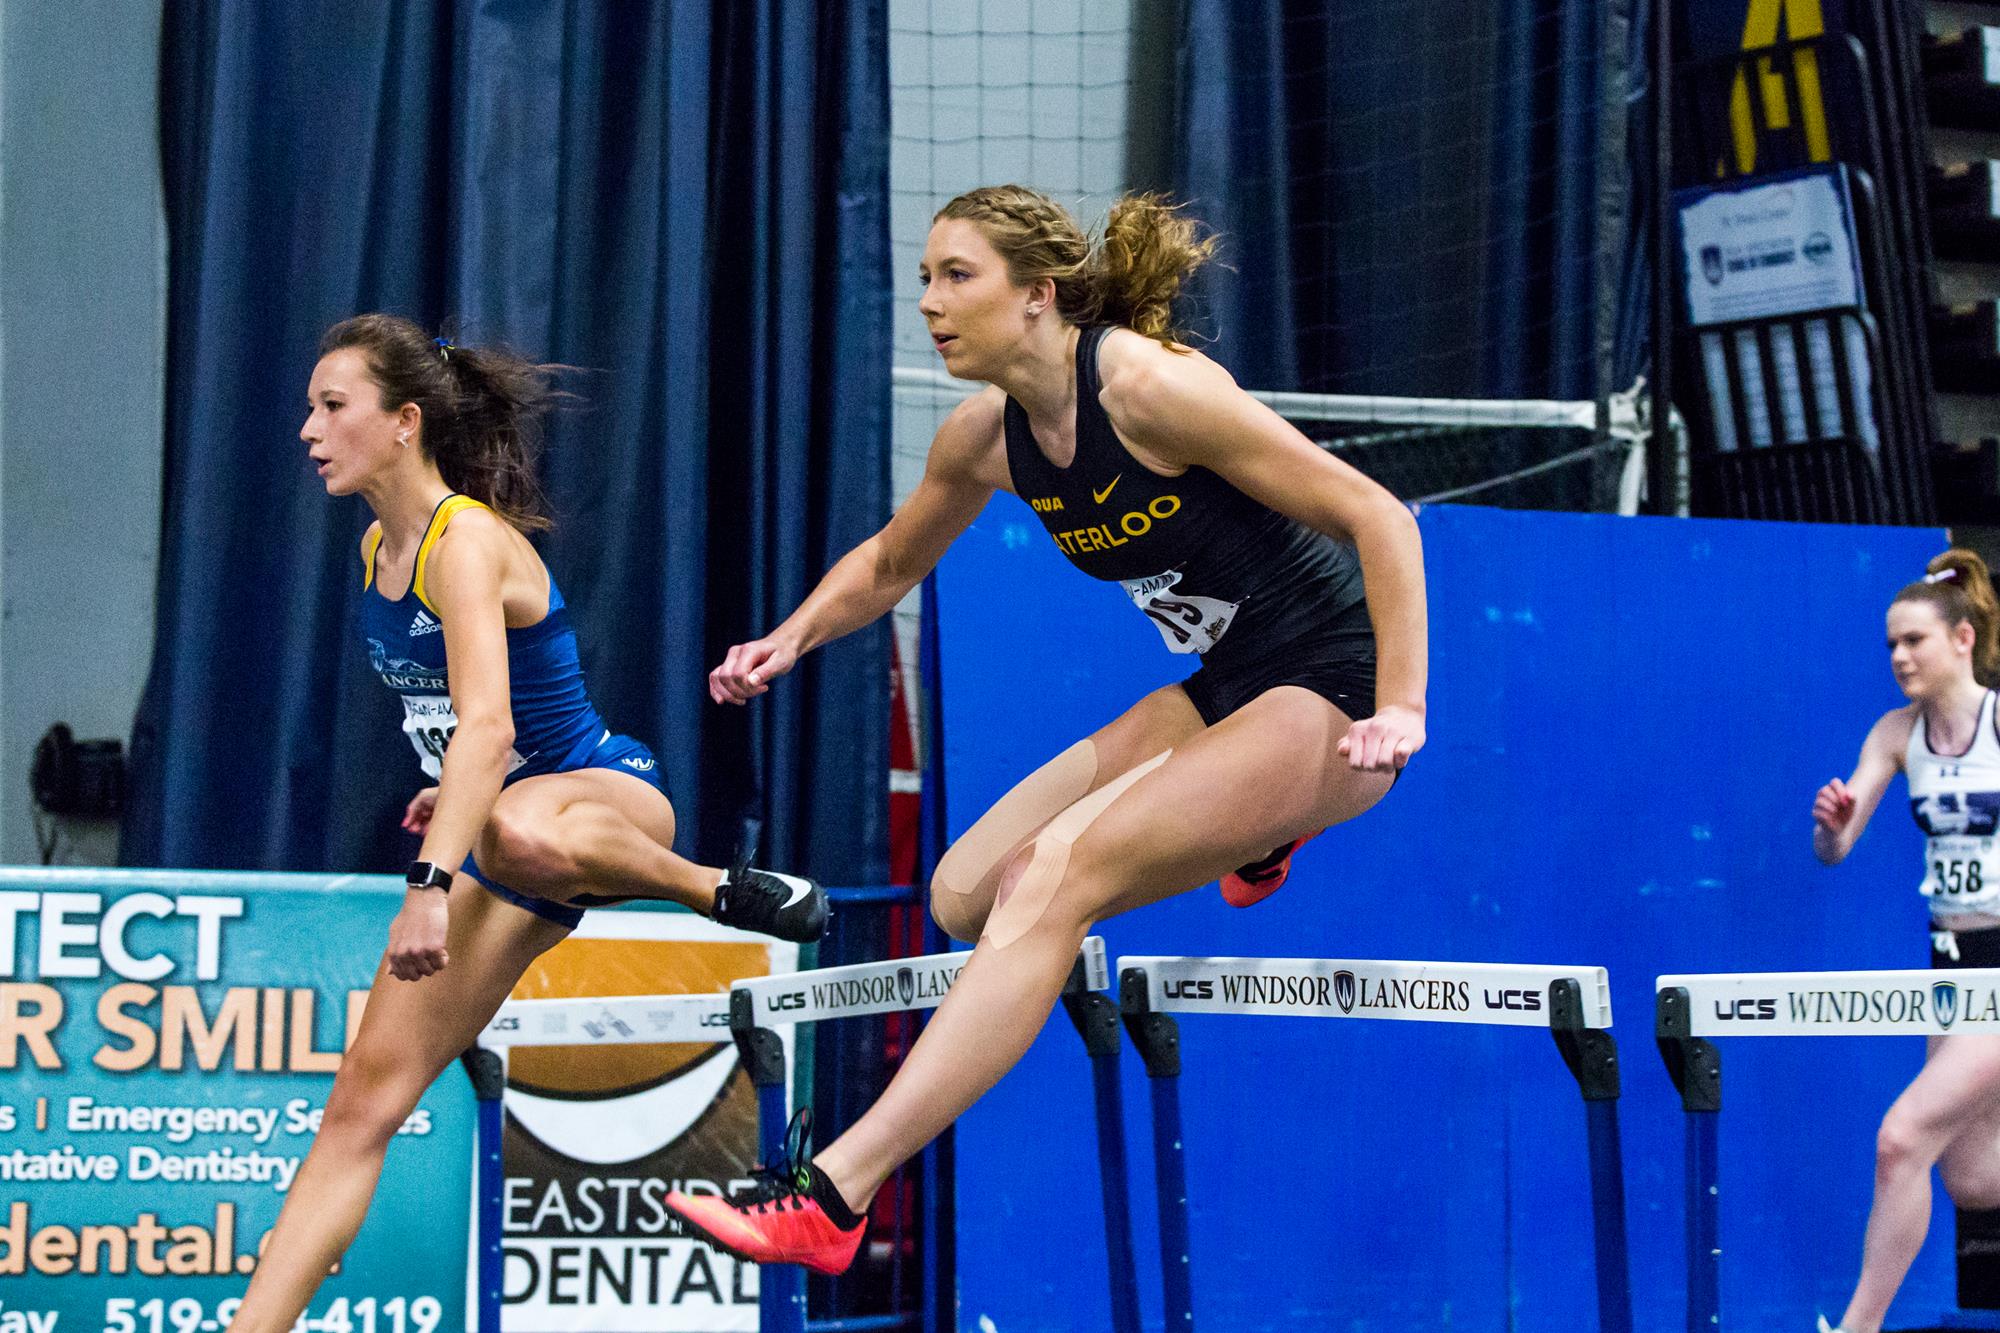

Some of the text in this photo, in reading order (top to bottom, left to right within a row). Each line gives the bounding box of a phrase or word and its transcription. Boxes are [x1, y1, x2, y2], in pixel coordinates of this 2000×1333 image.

[1031, 496, 1065, 512] OUA
[1934, 861, 1983, 894] 358
[768, 992, 806, 1012] UCS
[811, 976, 896, 1009] WINDSOR
[1163, 979, 1215, 1000] UCS
[1220, 973, 1331, 1006] WINDSOR
[1359, 979, 1471, 1012] LANCERS
[1483, 988, 1543, 1011] UCS
[1714, 998, 1779, 1021] UCS
[1787, 990, 1926, 1023] WINDSOR
[67, 1097, 276, 1143] Emergency
[128, 1146, 300, 1190] Dentistry
[501, 1247, 760, 1305] DENTAL
